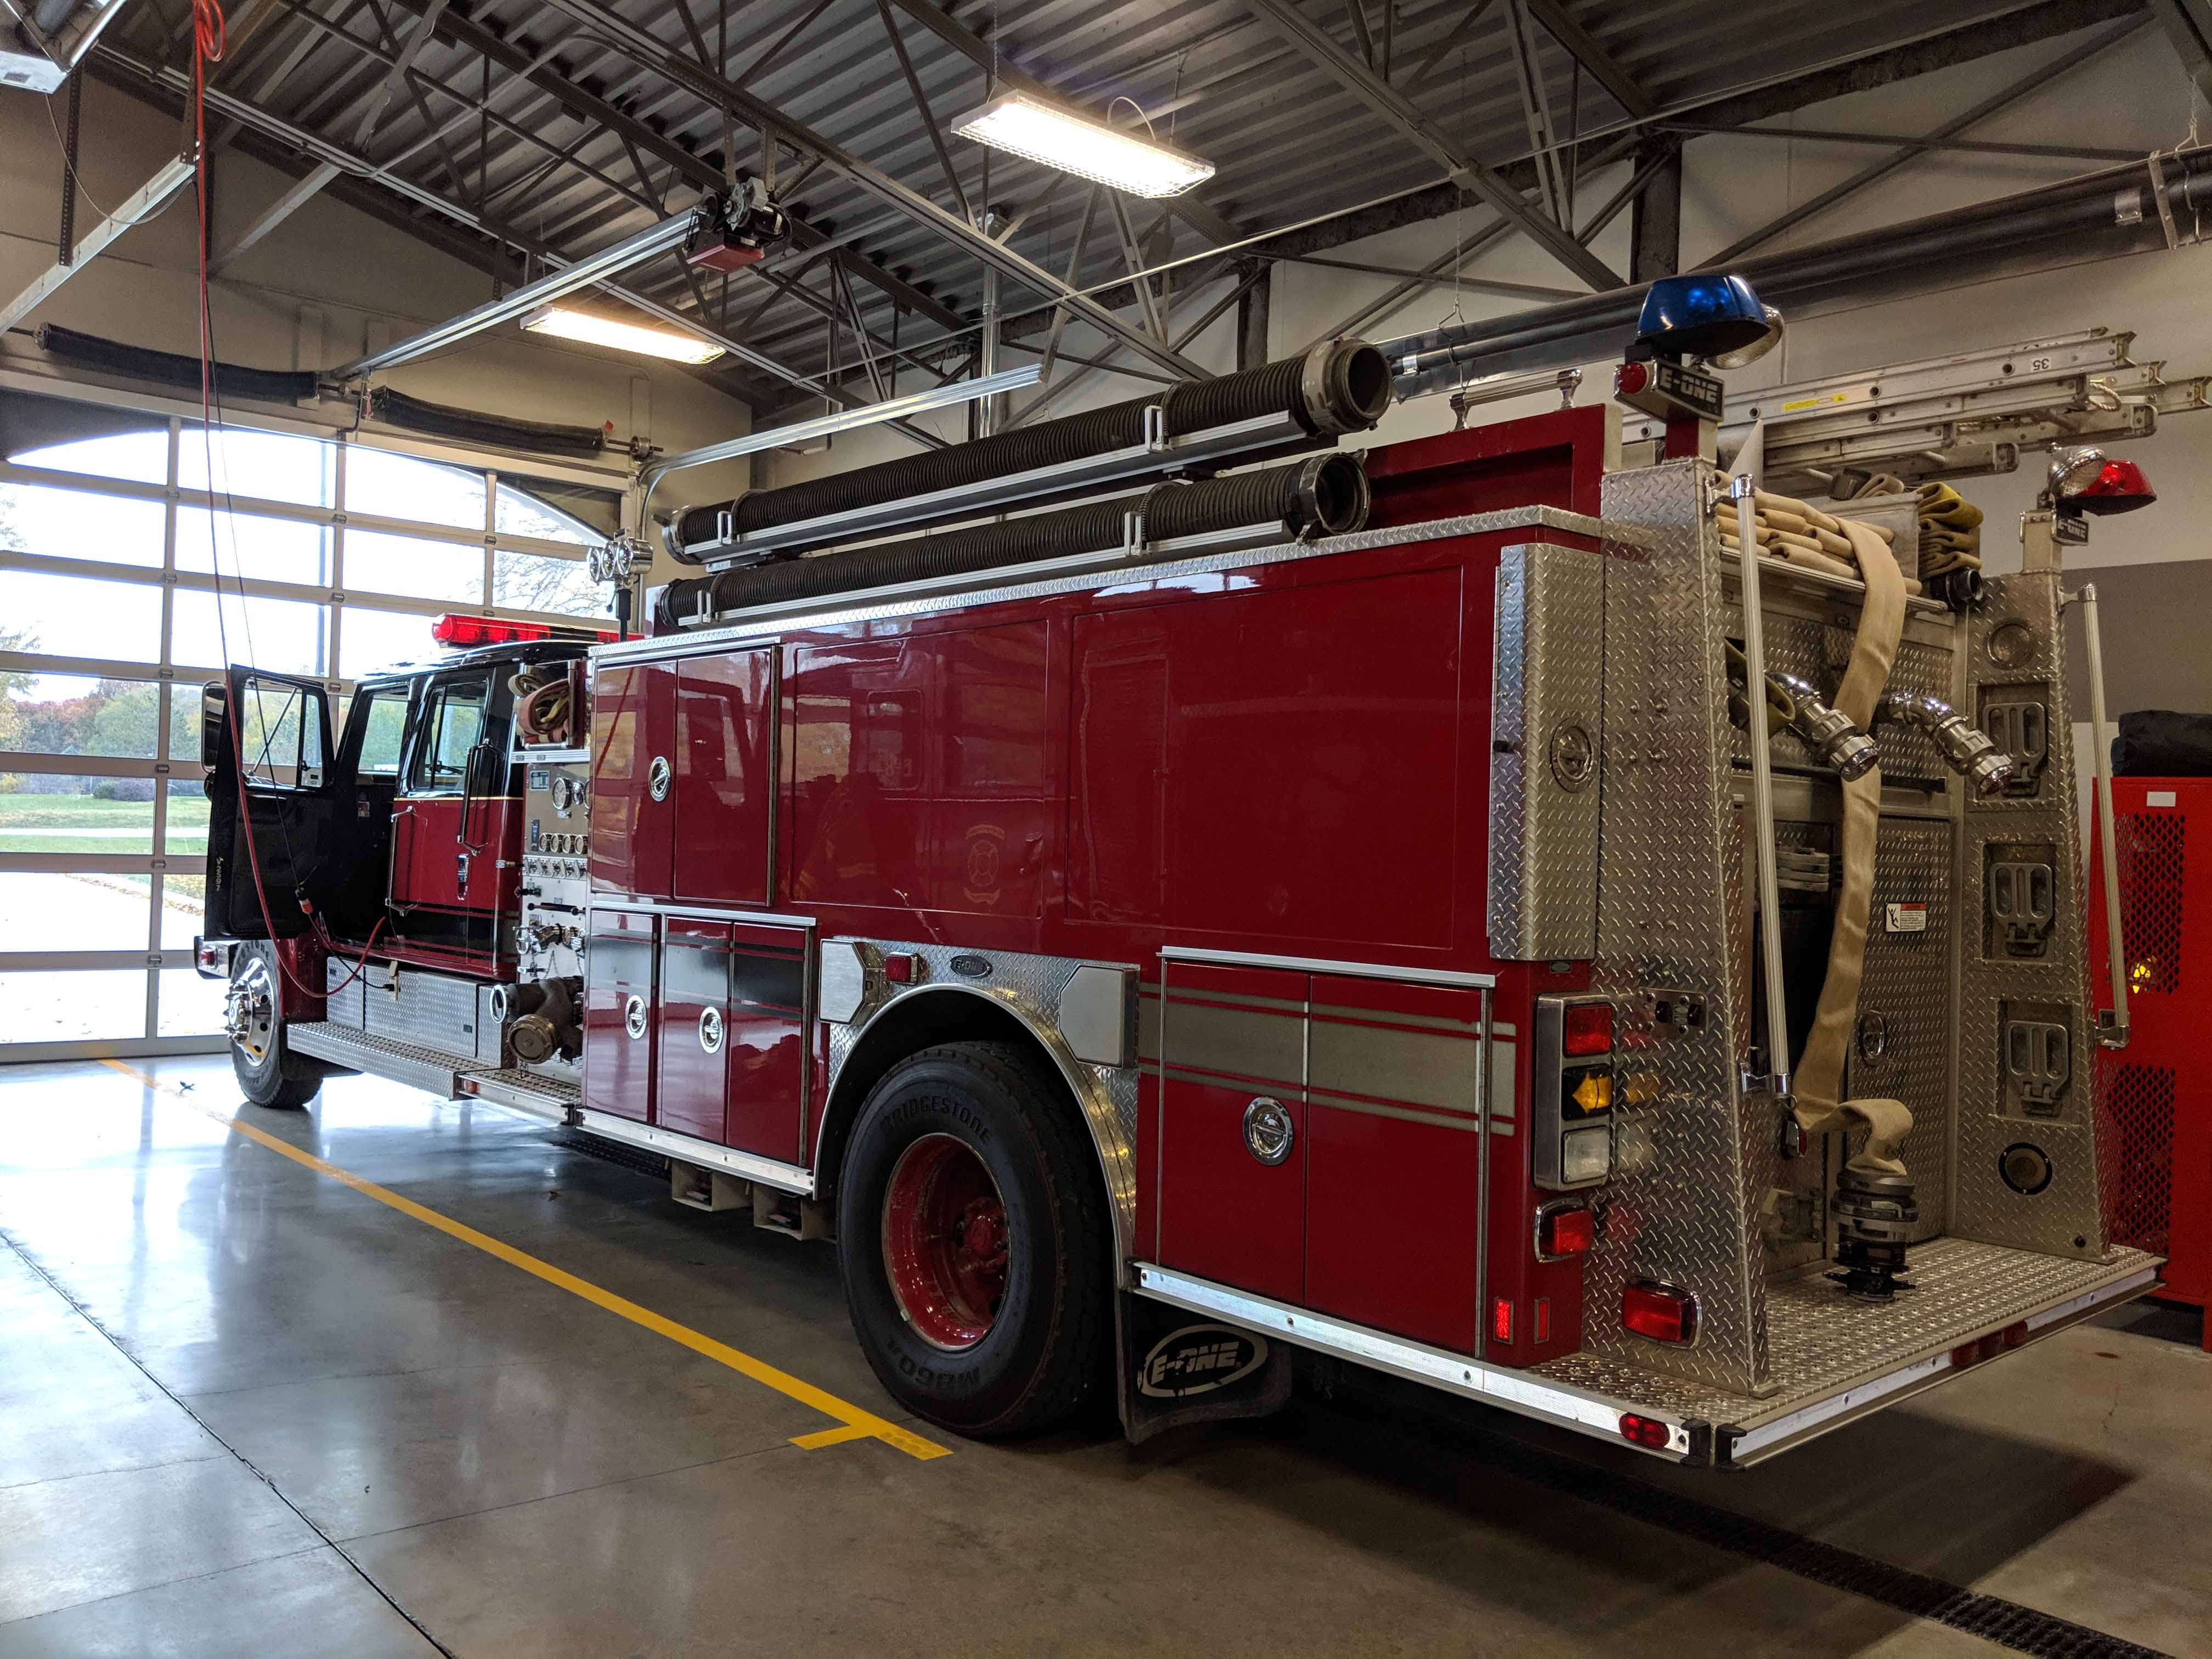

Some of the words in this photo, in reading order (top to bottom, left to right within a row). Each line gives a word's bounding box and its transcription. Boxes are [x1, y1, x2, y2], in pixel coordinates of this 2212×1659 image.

[2033, 358, 2050, 371] 35
[1660, 367, 1718, 403] E-ONE
[881, 1096, 992, 1144] BRIDGESTONE
